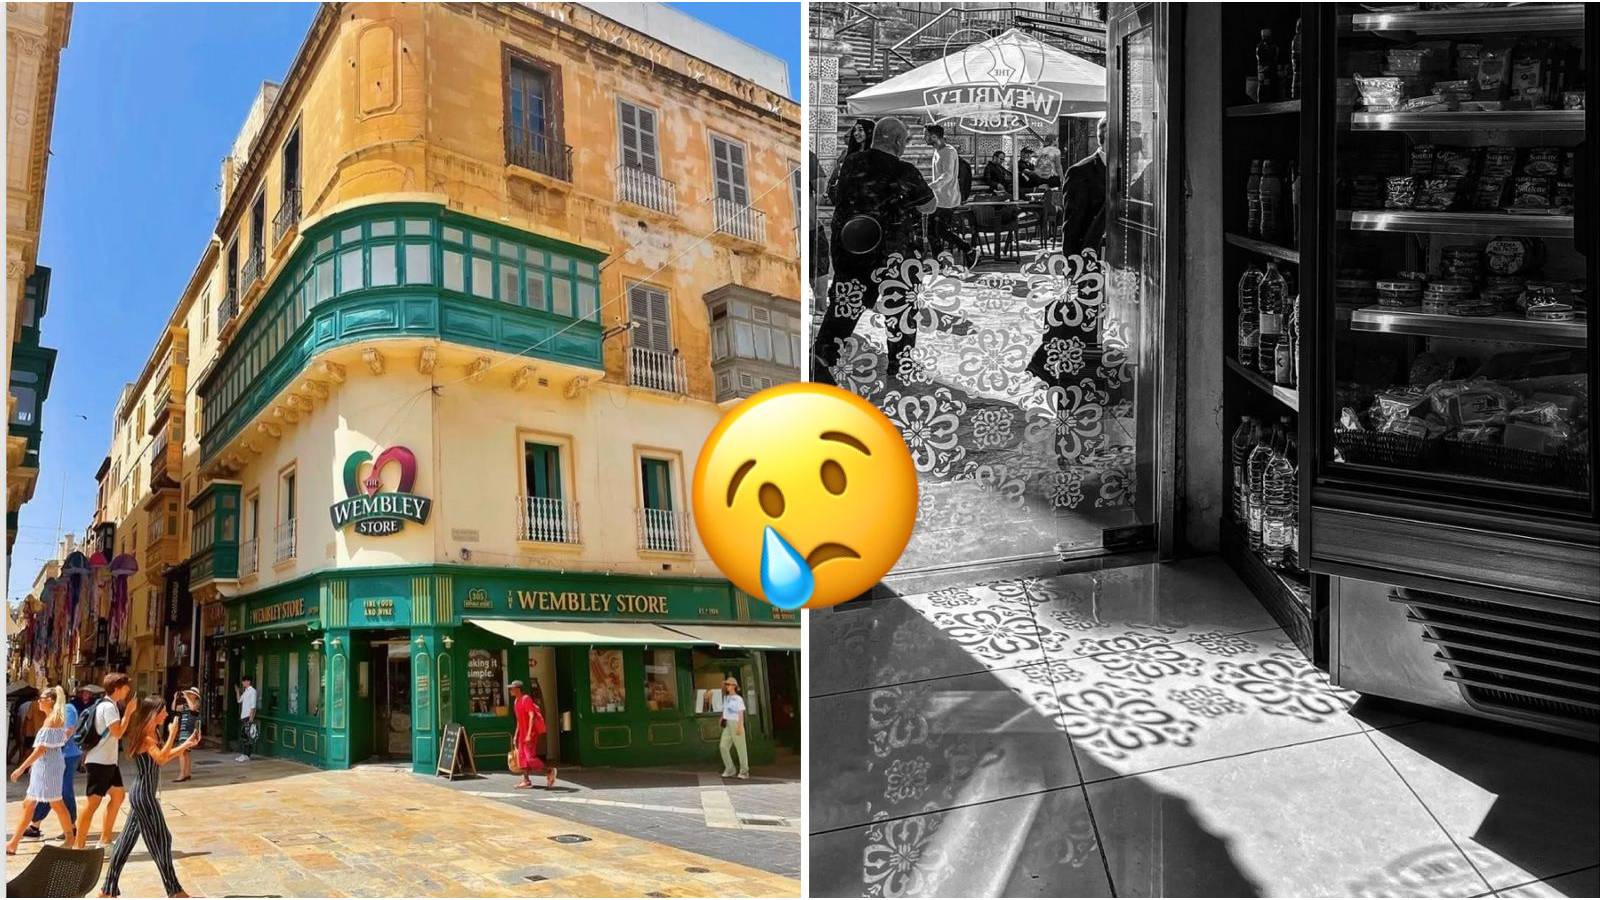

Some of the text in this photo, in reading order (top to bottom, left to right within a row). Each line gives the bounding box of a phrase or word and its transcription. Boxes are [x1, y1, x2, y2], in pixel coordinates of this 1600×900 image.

[334, 496, 425, 524] WEMBLEY
[360, 520, 398, 533] STORE
[281, 597, 305, 618] STORE
[518, 590, 614, 612] WEMBLEY
[616, 592, 669, 615] STORE
[491, 658, 498, 668] it
